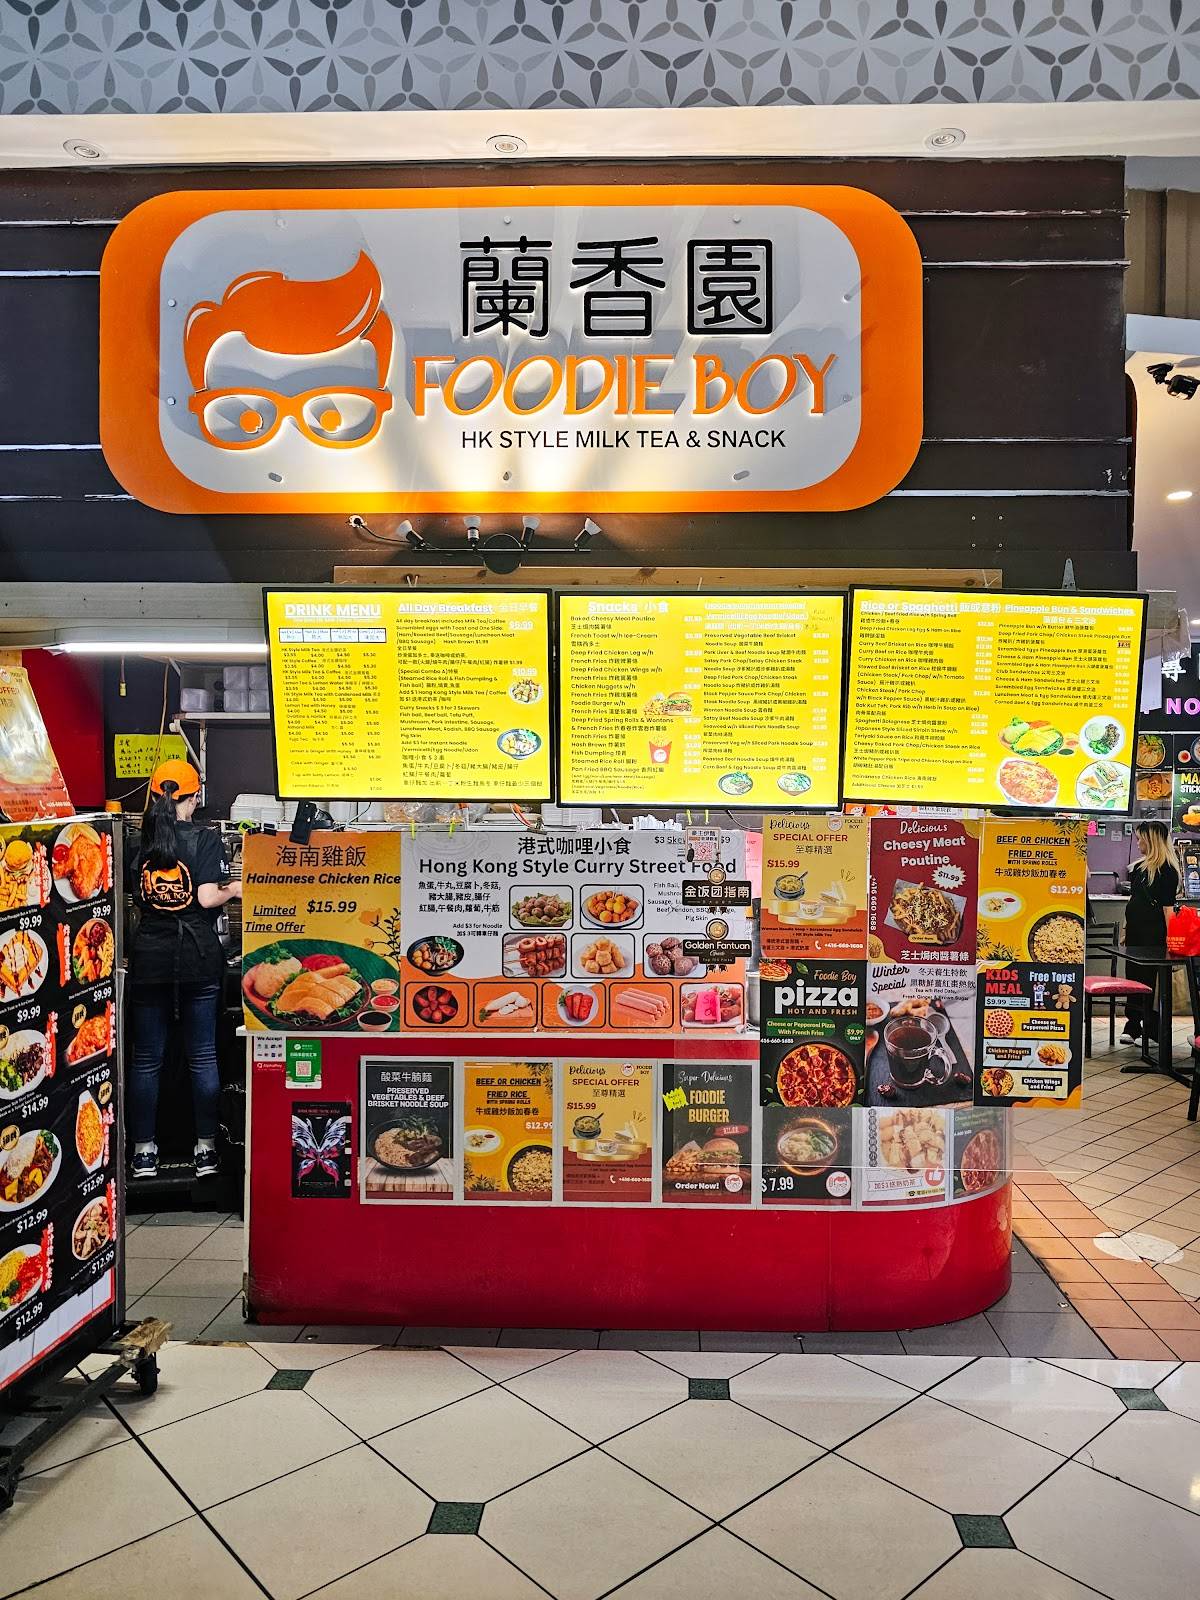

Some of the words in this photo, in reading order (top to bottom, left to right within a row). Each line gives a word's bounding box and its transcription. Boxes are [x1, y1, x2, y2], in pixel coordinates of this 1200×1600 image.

[460, 236, 774, 337] 蘭香園
[412, 354, 676, 416] FOODIE
[692, 353, 840, 416] BOY
[462, 431, 494, 449] HK
[499, 430, 569, 449] STYLE
[576, 430, 630, 449] MILK
[636, 430, 680, 448] TEA
[685, 430, 701, 448] &
[706, 430, 786, 449] SNACK
[284, 604, 333, 617] DRINK
[336, 604, 382, 618] MENU
[399, 604, 412, 613] All
[416, 604, 435, 614] Day
[440, 604, 493, 614] Breakfast
[588, 601, 638, 612] Snacks
[860, 602, 886, 612] Rice
[888, 604, 897, 612] or
[902, 602, 956, 614] Spaghetti
[1006, 604, 1049, 614] Pineapple
[1052, 606, 1069, 614] Bun
[1080, 606, 1134, 616] Sandwiches
[770, 818, 810, 830] Delicious
[900, 821, 948, 834] Delicious
[773, 834, 814, 842] SPECIAL
[816, 834, 848, 842] OFFER
[884, 839, 930, 852] Cheesy
[932, 836, 966, 848] Meat
[996, 835, 1017, 844] BEEF
[1020, 836, 1032, 844] OR
[1034, 836, 1070, 845] CHICKEN
[518, 837, 632, 856] 港式咖哩小食
[276, 845, 367, 867] 海南雞飯
[901, 854, 950, 867] Poutine
[1008, 850, 1032, 858] FRIED
[1036, 850, 1054, 859] RICE
[419, 859, 468, 878] Hong
[472, 859, 518, 878] Kong
[523, 859, 570, 878] Style
[574, 860, 623, 878] Curry
[629, 859, 685, 873] Street
[767, 859, 800, 868] $15.99
[246, 872, 315, 884] Hainanese
[318, 873, 369, 884] Chicken
[373, 873, 401, 884] Rice
[937, 870, 960, 882] $11.99
[995, 868, 1067, 879] 牛或雞炒飯加春卷
[684, 885, 750, 898] 金饭团指南
[1050, 885, 1083, 894] $12.99
[92, 904, 111, 919] $9.99
[253, 905, 296, 916] Limited
[306, 900, 357, 913] $15.99
[19, 914, 42, 930] $9.99
[245, 922, 272, 933] Time
[275, 922, 306, 933] Offer
[685, 942, 715, 950] Golden
[717, 942, 750, 950] Fantuan
[814, 970, 838, 980] Foodie
[842, 970, 857, 984] Boy
[872, 965, 910, 979] Winter
[986, 969, 1018, 981] KIDS
[1029, 971, 1049, 982] Free
[1051, 972, 1076, 983] Toys!
[872, 979, 906, 994] Special
[985, 983, 1023, 995] MEAL
[93, 988, 112, 1002] $9.99
[774, 979, 859, 1014] pizza
[16, 1005, 41, 1024] $9.99
[569, 1065, 606, 1076] Delicious
[86, 1068, 110, 1088] $14.99
[689, 1090, 726, 1104] FOODIE
[21, 1096, 48, 1119] $14.99
[567, 1102, 596, 1110] $15.99
[688, 1109, 730, 1123] BURGER
[82, 1174, 105, 1197] $12.99
[770, 1176, 794, 1191] 7.99
[16, 1208, 48, 1234] $12.99
[91, 1250, 114, 1275] $12.99
[15, 1302, 43, 1330] $12.99
